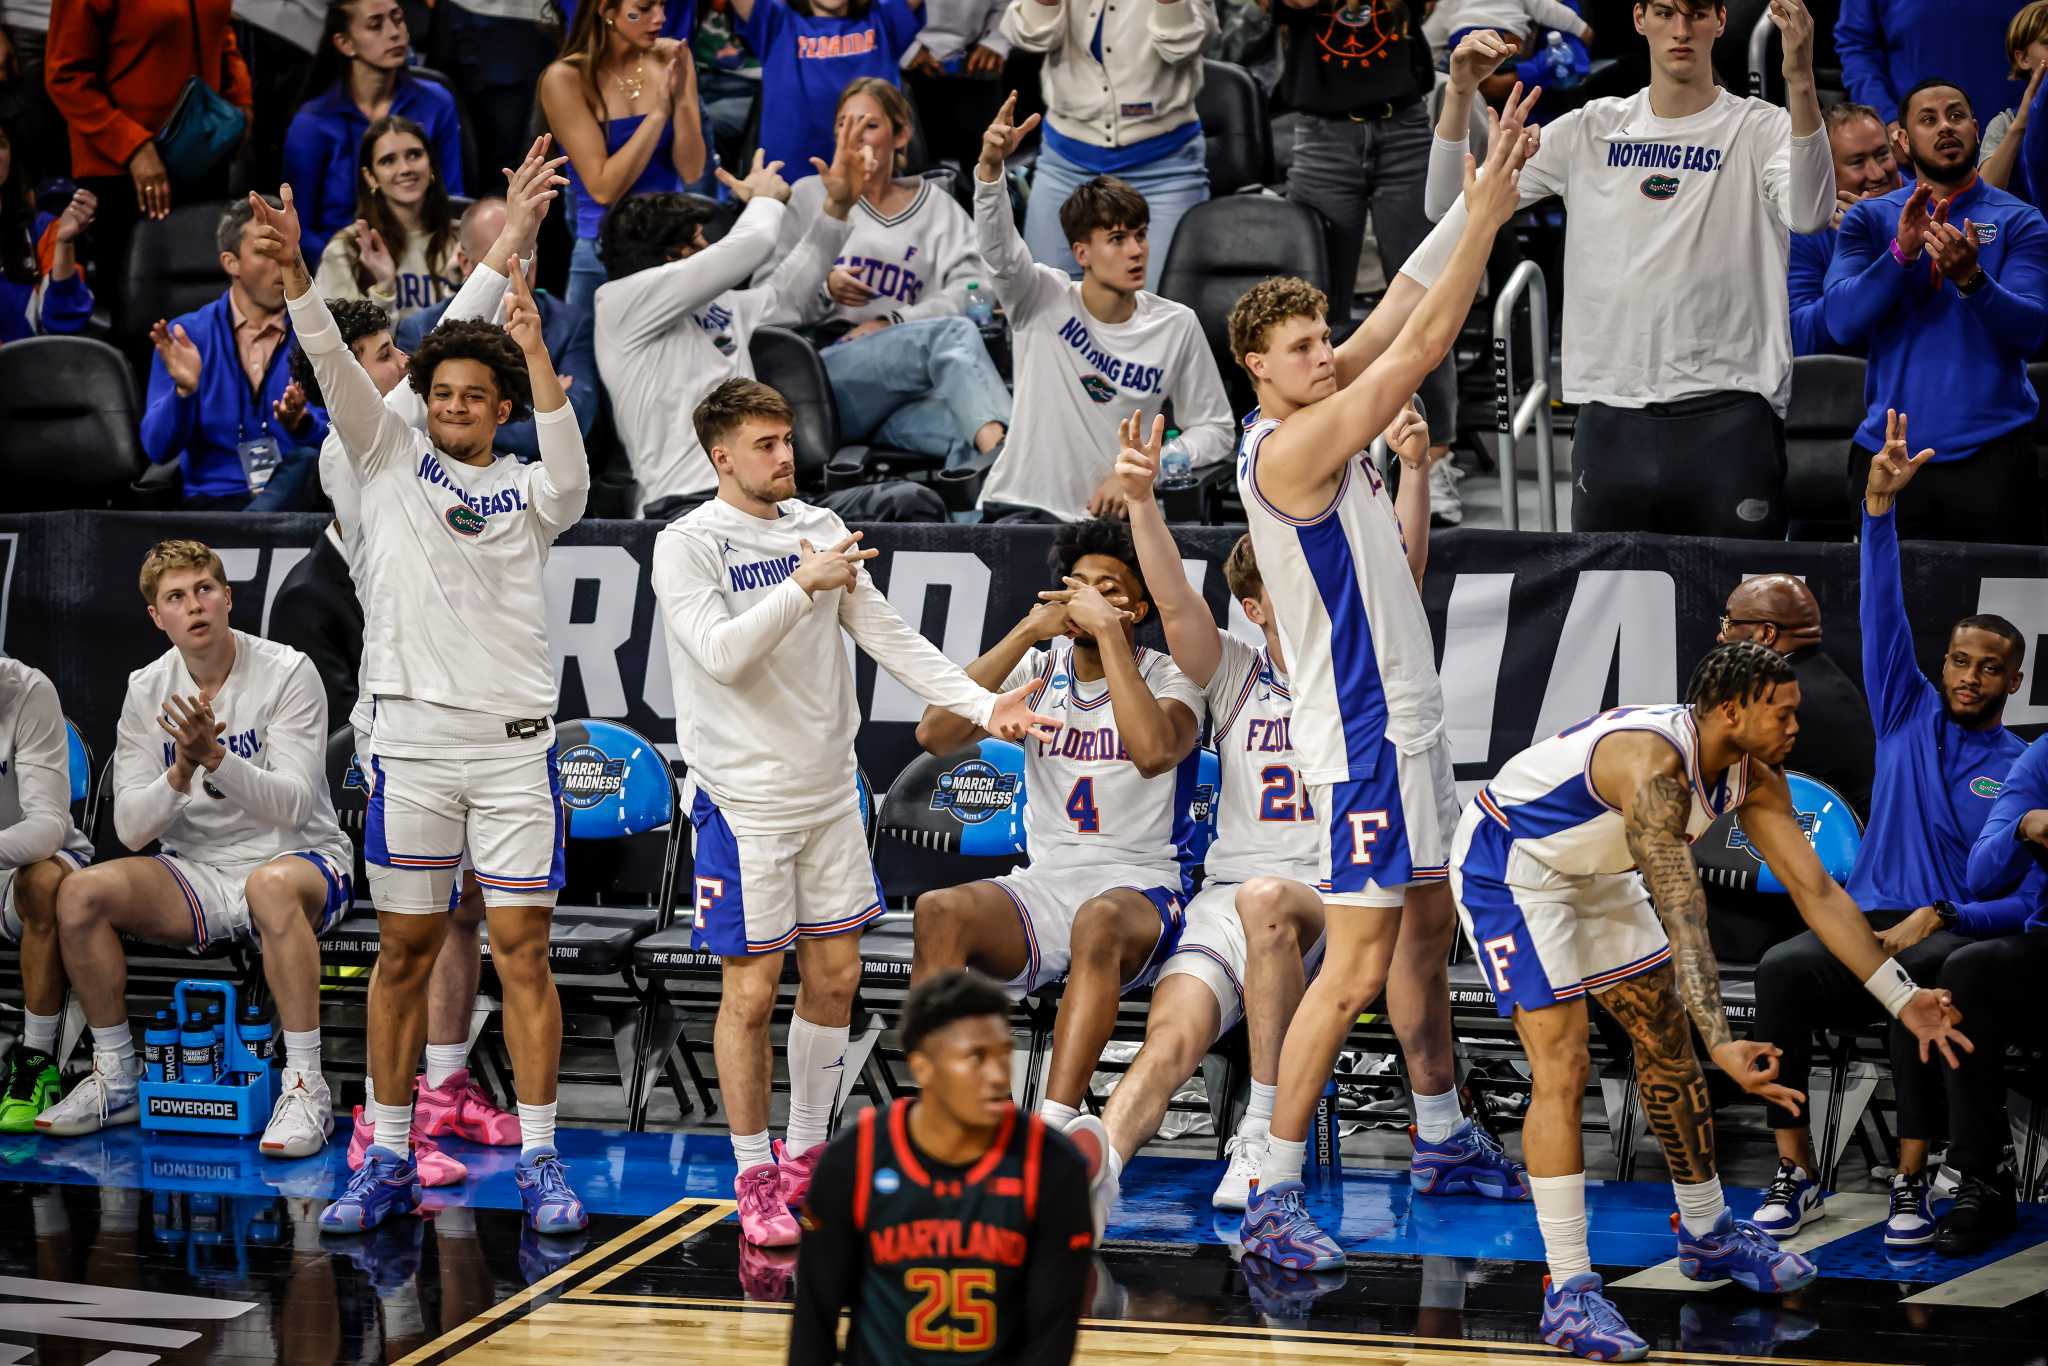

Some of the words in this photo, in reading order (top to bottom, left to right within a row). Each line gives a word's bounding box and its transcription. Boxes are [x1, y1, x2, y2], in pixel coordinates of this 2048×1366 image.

[1607, 142, 1681, 169] NOTHING
[561, 761, 604, 776] MARCH
[565, 775, 621, 789] MADNESS
[952, 776, 995, 791] MARCH
[956, 790, 1013, 805] MADNESS
[1066, 776, 1100, 833] 4
[1346, 810, 1389, 864] F
[695, 877, 724, 928] F
[335, 940, 359, 951] FINAL
[555, 947, 579, 958] FOUR
[652, 952, 668, 963] THE
[670, 953, 693, 964] ROAD
[695, 954, 706, 964] TO
[1484, 934, 1517, 991] F
[864, 961, 888, 973] ROAD
[889, 963, 900, 973] TO
[1460, 991, 1484, 1002] ROAD
[1317, 1098, 1329, 1166] POWERADE
[869, 1219, 1028, 1268] MARYLAND
[904, 1267, 997, 1352] 25
